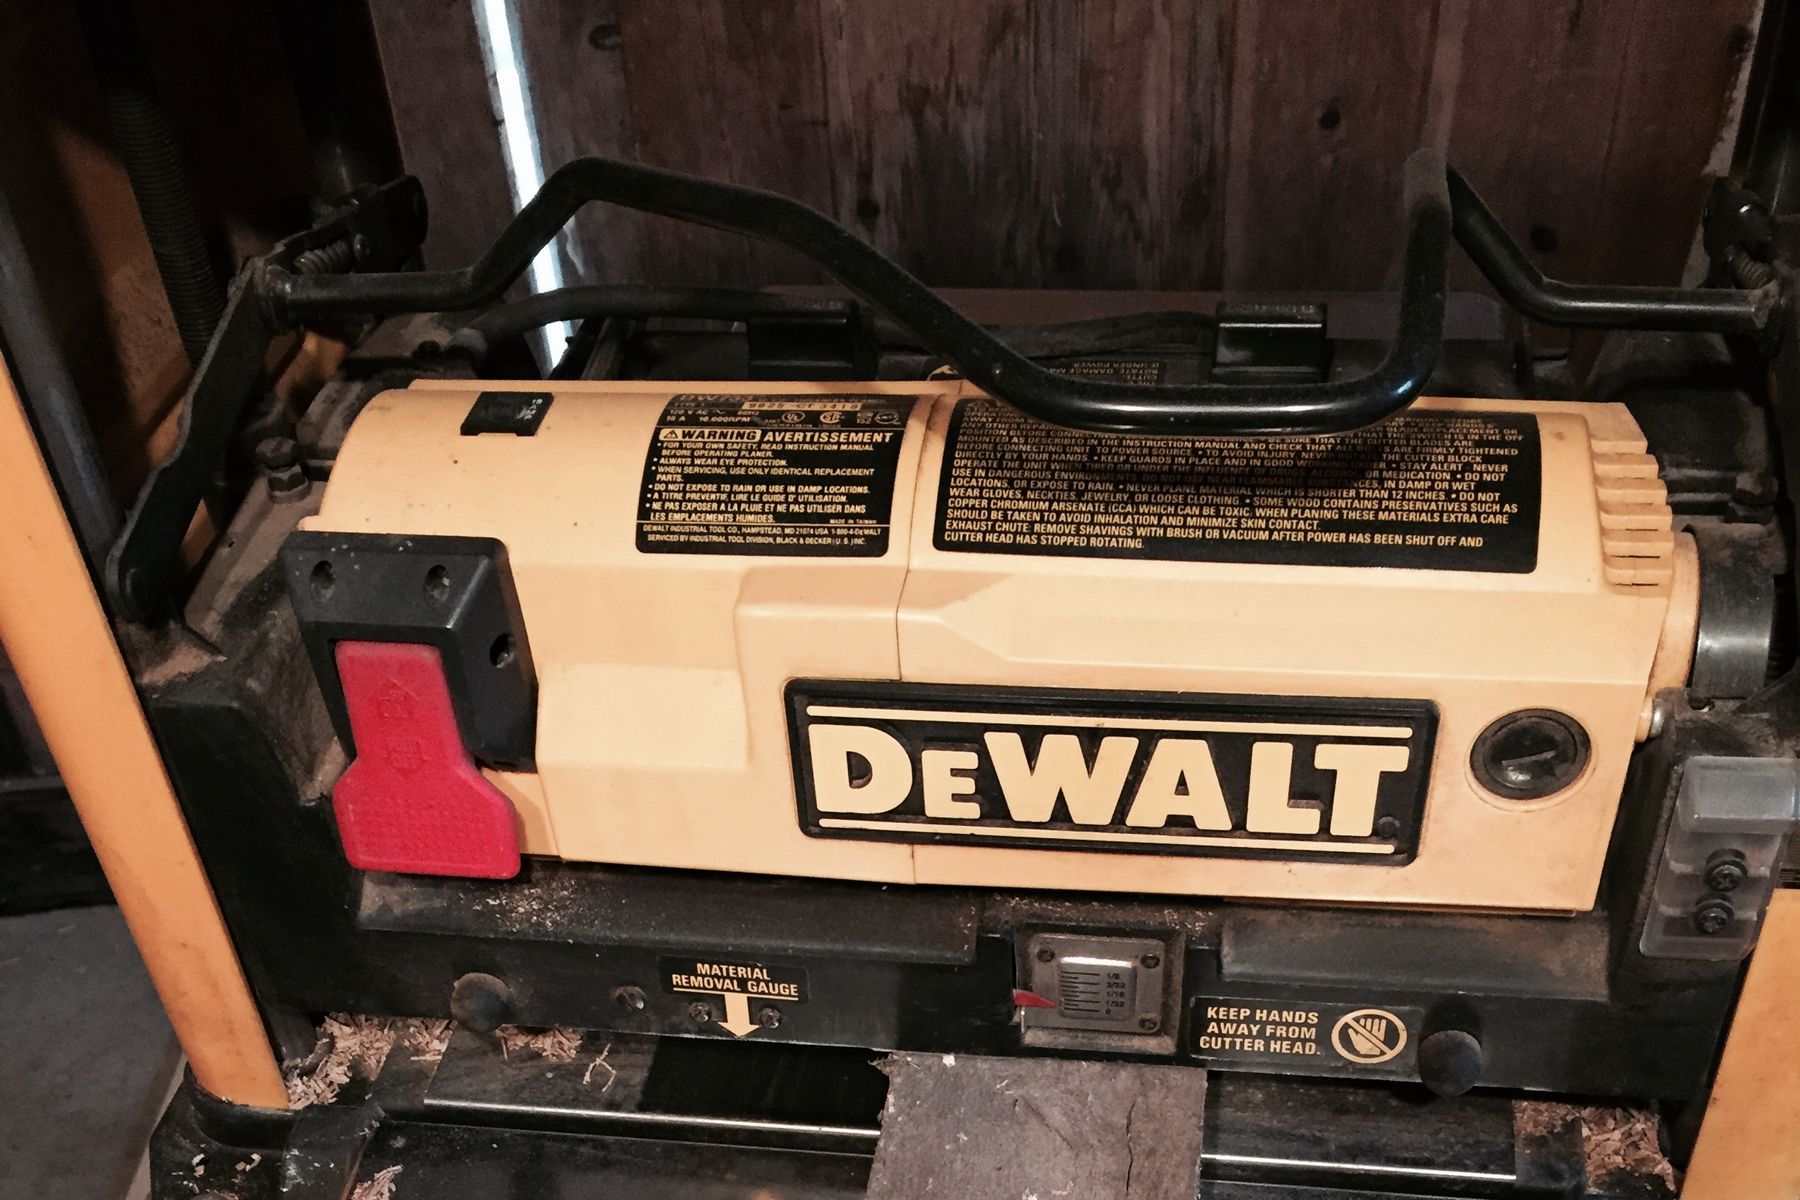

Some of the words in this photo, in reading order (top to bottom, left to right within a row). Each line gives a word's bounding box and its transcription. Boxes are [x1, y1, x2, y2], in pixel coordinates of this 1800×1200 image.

[682, 430, 757, 440] WARNING
[763, 432, 893, 443] AVERTISSEMENT
[814, 468, 875, 476] REPLACEMENT
[798, 485, 822, 493] DAMP
[824, 486, 870, 494] LOCATIONS.
[1359, 489, 1388, 498] THAN
[1391, 491, 1402, 499] 12
[1459, 492, 1474, 501] DO
[1477, 493, 1501, 501] NOT
[652, 502, 662, 510] NE
[664, 502, 680, 510] PAS
[682, 503, 718, 511] EXPOSER
[720, 503, 726, 511] A
[728, 503, 738, 511] LA
[740, 504, 762, 512] PLUIE
[764, 504, 775, 512] ET
[777, 504, 788, 512] NE
[790, 504, 805, 513] PAS
[807, 504, 842, 513] UTILISER
[844, 505, 866, 513] DANS
[949, 488, 980, 497] WEAR
[1134, 493, 1148, 502] OR
[1151, 494, 1184, 503] LOOSE
[1253, 497, 1284, 506] SOME
[1287, 498, 1320, 507] WOOD
[1323, 499, 1378, 509] CONTAINS
[1382, 500, 1467, 512] PRESERVATIVES
[1470, 502, 1500, 512] SUCH
[1503, 504, 1518, 513] AS
[650, 513, 666, 521] LES
[668, 513, 733, 522] EMPLACEMENTS
[736, 514, 775, 523] HUMIDES.
[947, 509, 988, 519] SHOULD
[990, 510, 1004, 520] BE
[1007, 511, 1040, 521] TAKEN
[1043, 512, 1056, 522] TO
[1059, 512, 1091, 523] AVOID
[1094, 514, 1158, 525] INHALATION
[1160, 516, 1184, 526] AND
[1187, 517, 1238, 527] MINIMIZE
[1240, 519, 1266, 528] SKIN
[948, 498, 988, 508] COPPER
[990, 500, 1049, 510] CHROMIUM
[1051, 501, 1105, 512] ARSENATE
[1109, 503, 1136, 513] (CCA)
[1139, 504, 1175, 514] WHICH
[1177, 505, 1200, 515] CAN
[1202, 506, 1216, 515] BE
[1255, 507, 1288, 517] WHEN
[1291, 508, 1339, 519] PLANING
[1342, 510, 1376, 520] THESE
[1378, 511, 1440, 522] MATERIALS
[1443, 513, 1478, 523] EXTRA
[1480, 514, 1509, 524] CARE
[944, 531, 983, 542] CUTTER
[985, 533, 1013, 543] HEAD
[1016, 534, 1038, 544] HAS
[1040, 535, 1087, 546] STOPPED
[1090, 537, 1144, 548] ROTATING.
[946, 520, 994, 531] EXHAUST
[1034, 523, 1077, 534] REMOVE
[1080, 525, 1133, 536] SHAVINGS
[1136, 527, 1164, 537] WITH
[1166, 528, 1202, 538] BRUSH
[1205, 529, 1220, 539] OR
[1222, 529, 1269, 540] VACUUM
[1272, 531, 1304, 542] AFTER
[1307, 532, 1346, 543] POWER
[1348, 533, 1371, 544] HAS
[1374, 534, 1402, 545] BEEN
[1405, 535, 1435, 546] SHUT
[1437, 536, 1457, 546] OFF
[1459, 536, 1483, 547] AND
[697, 963, 770, 980] MATERIAL
[672, 974, 741, 991] REMOVAL
[748, 981, 798, 996] GAUGE
[1207, 1006, 1250, 1020] KEEP
[1255, 1009, 1319, 1024] HANDS
[1207, 1022, 1260, 1036] AWAY
[1266, 1025, 1316, 1039] FROM
[1200, 1036, 1264, 1051] CUTTER
[1270, 1040, 1320, 1055] HEAD.
